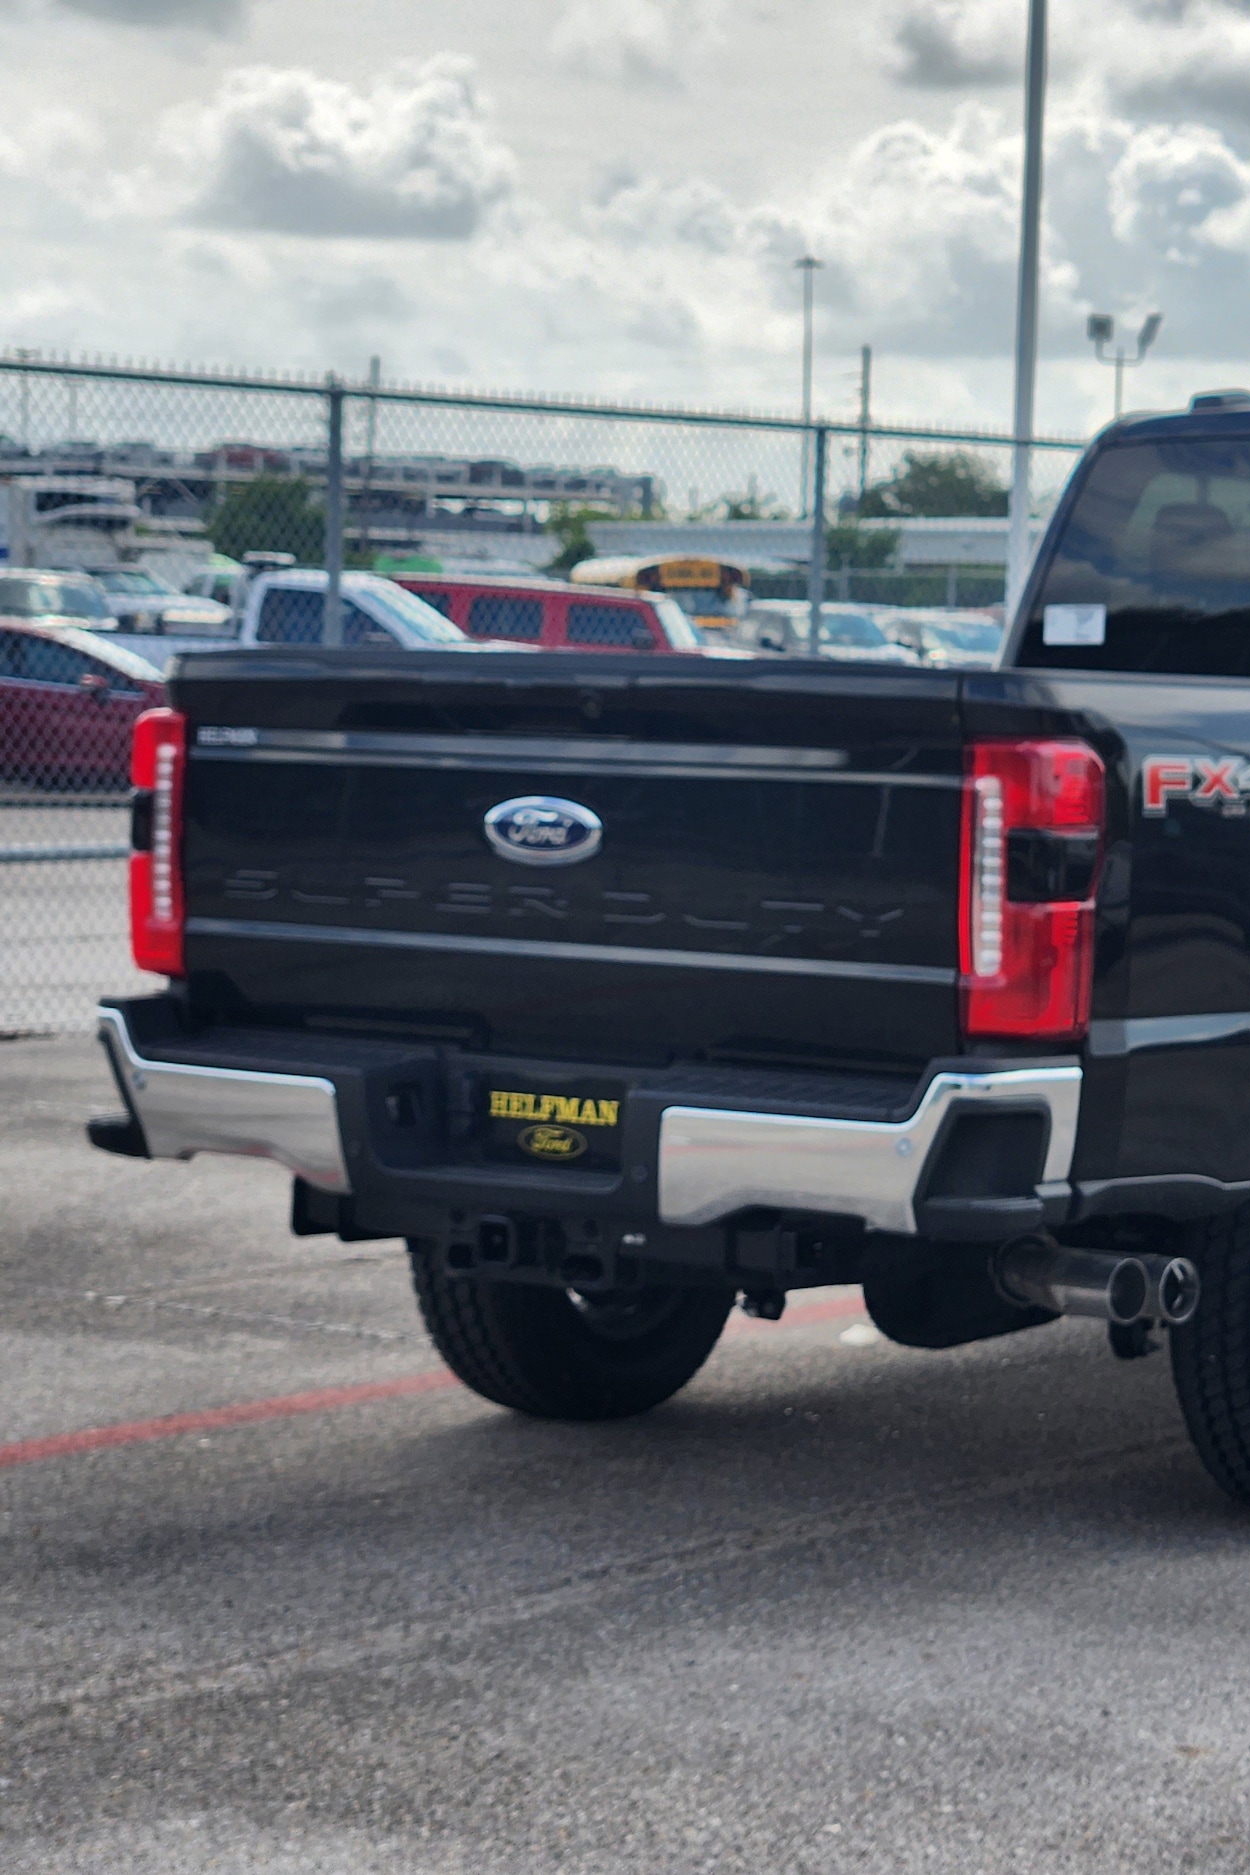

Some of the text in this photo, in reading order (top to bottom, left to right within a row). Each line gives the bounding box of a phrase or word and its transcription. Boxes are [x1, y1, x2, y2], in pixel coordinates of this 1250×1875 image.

[507, 808, 574, 845] Ford
[222, 869, 905, 940] SUPER DUTY
[490, 1090, 619, 1126] HELFMAN
[530, 1126, 573, 1152] Ford
